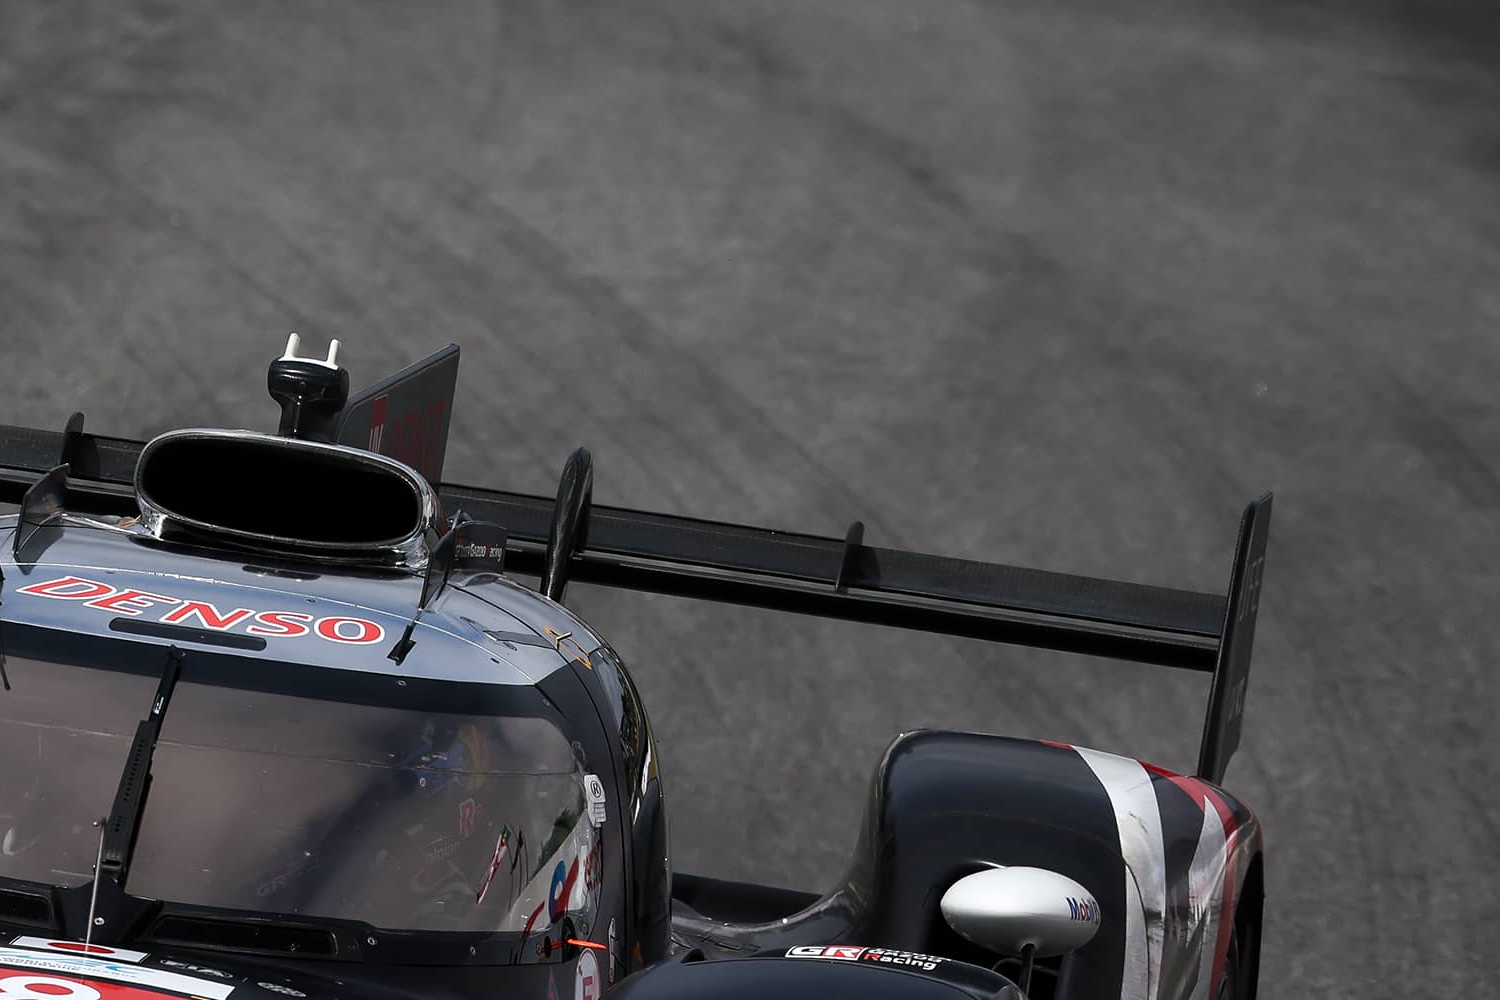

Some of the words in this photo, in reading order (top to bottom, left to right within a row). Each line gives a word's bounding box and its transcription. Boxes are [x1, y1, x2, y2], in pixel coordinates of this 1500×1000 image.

[20, 576, 384, 645] DENSO
[791, 945, 860, 958] GR
[863, 952, 938, 971] Racing
